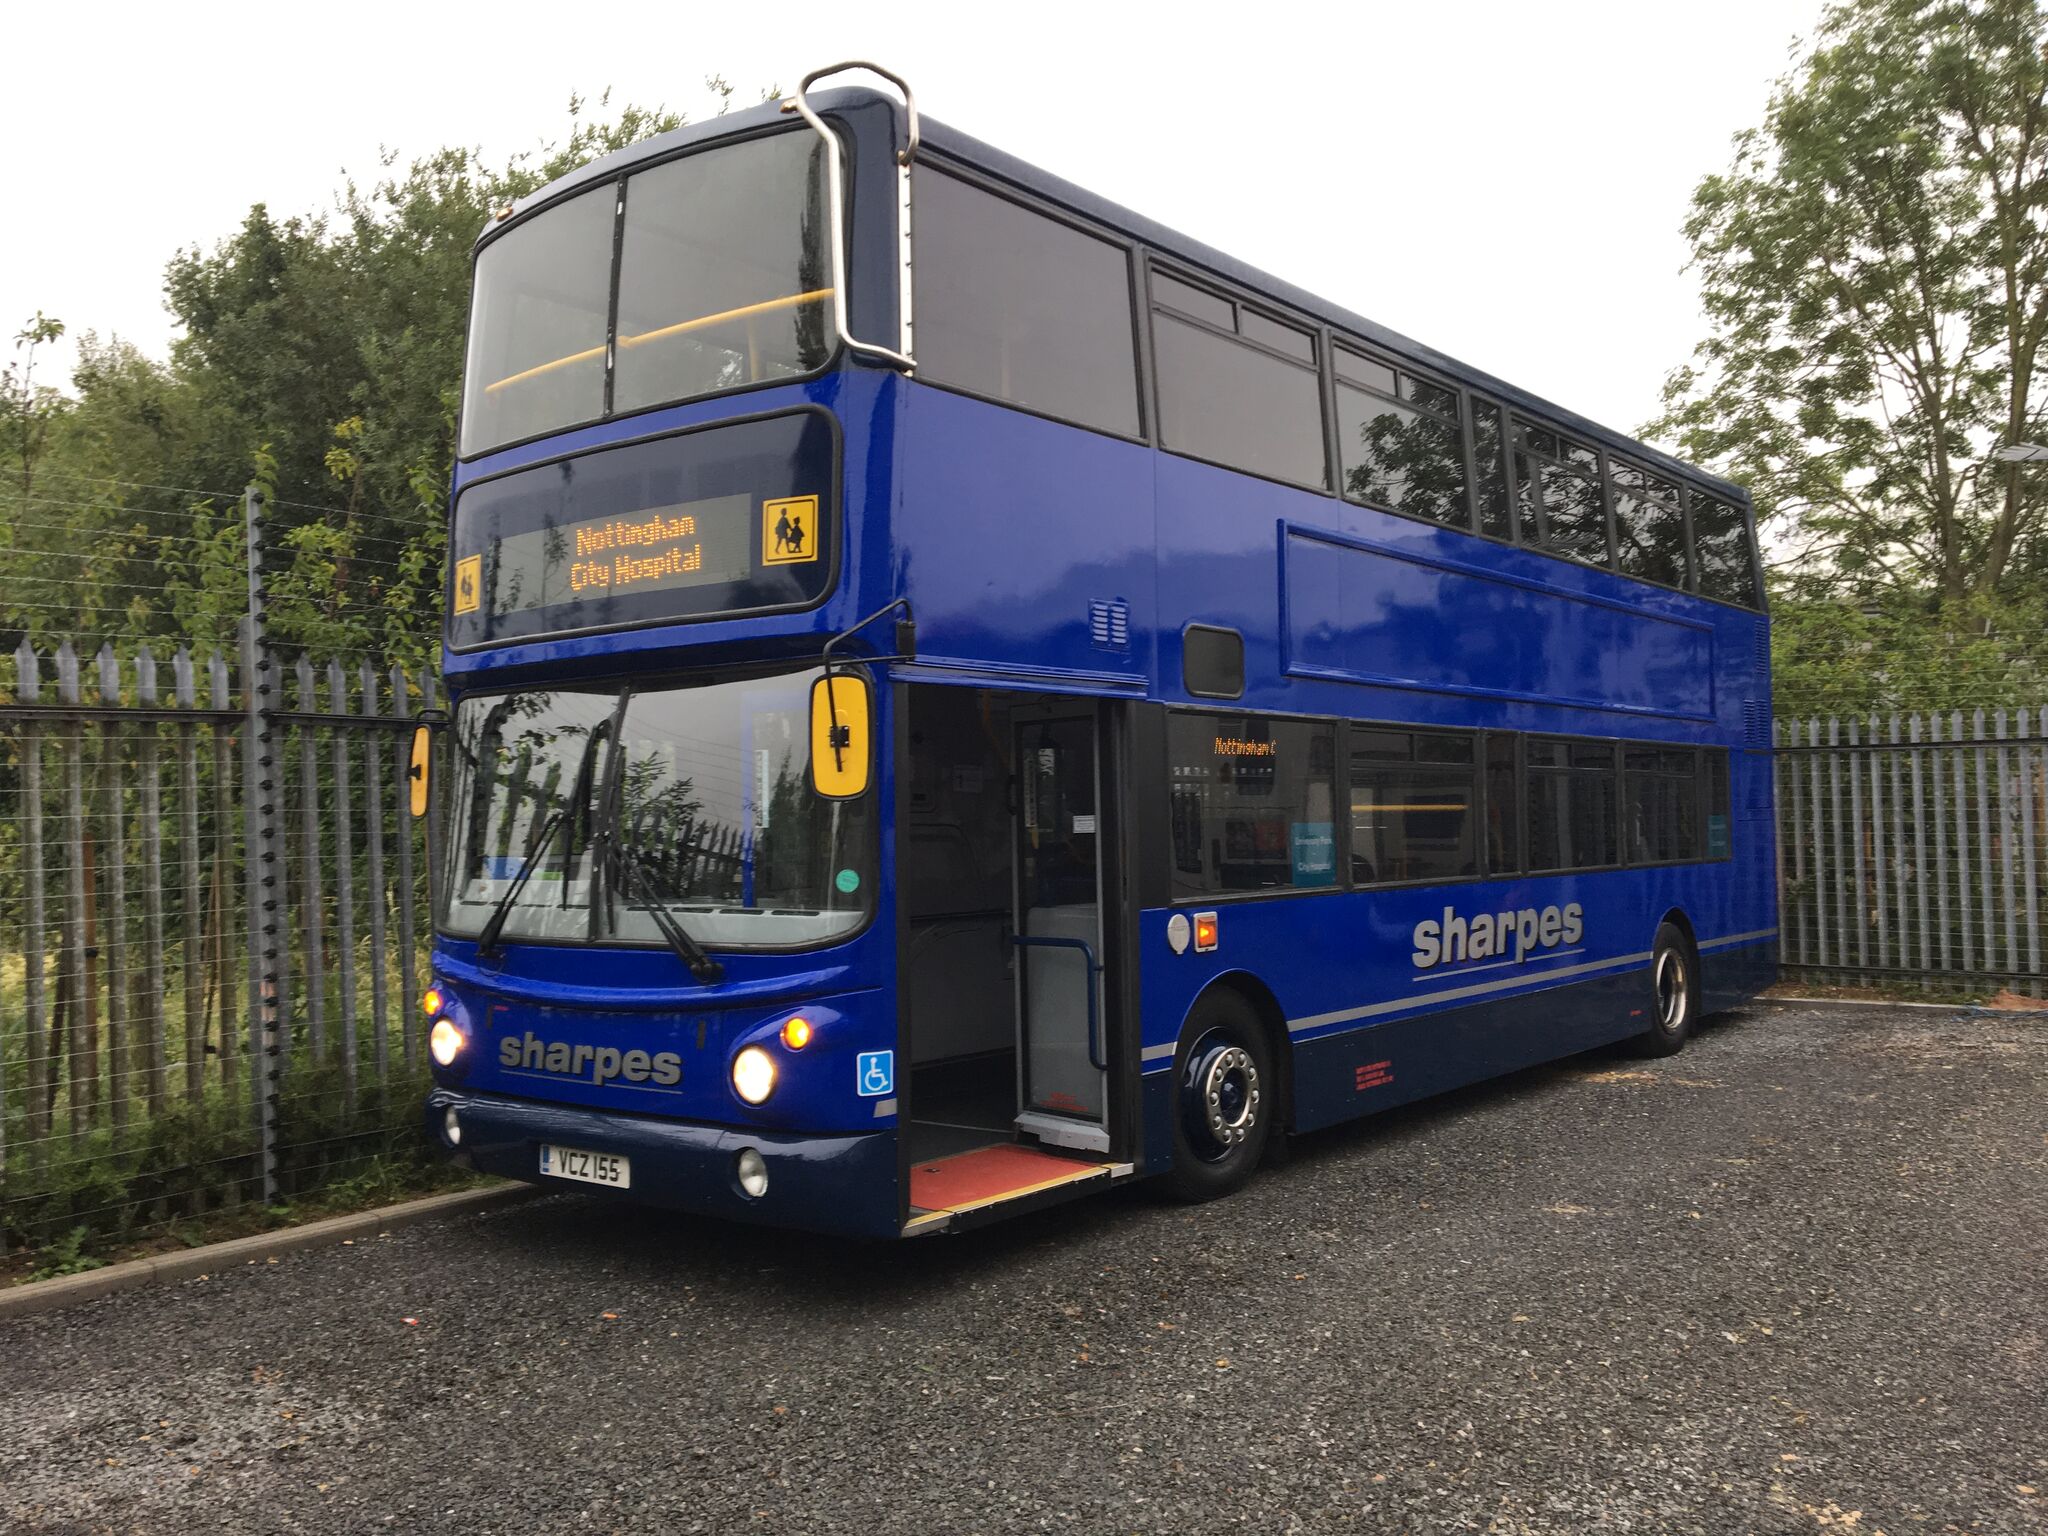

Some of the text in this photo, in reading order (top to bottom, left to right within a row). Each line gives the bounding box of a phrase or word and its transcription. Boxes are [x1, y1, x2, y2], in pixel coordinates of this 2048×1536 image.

[576, 515, 695, 556] Nottingham
[571, 544, 700, 591] City Hospital
[1214, 737, 1269, 756] Nottingham
[1411, 902, 1584, 969] sharpes
[499, 1031, 682, 1086] sharpes
[559, 1150, 589, 1177] VCZ
